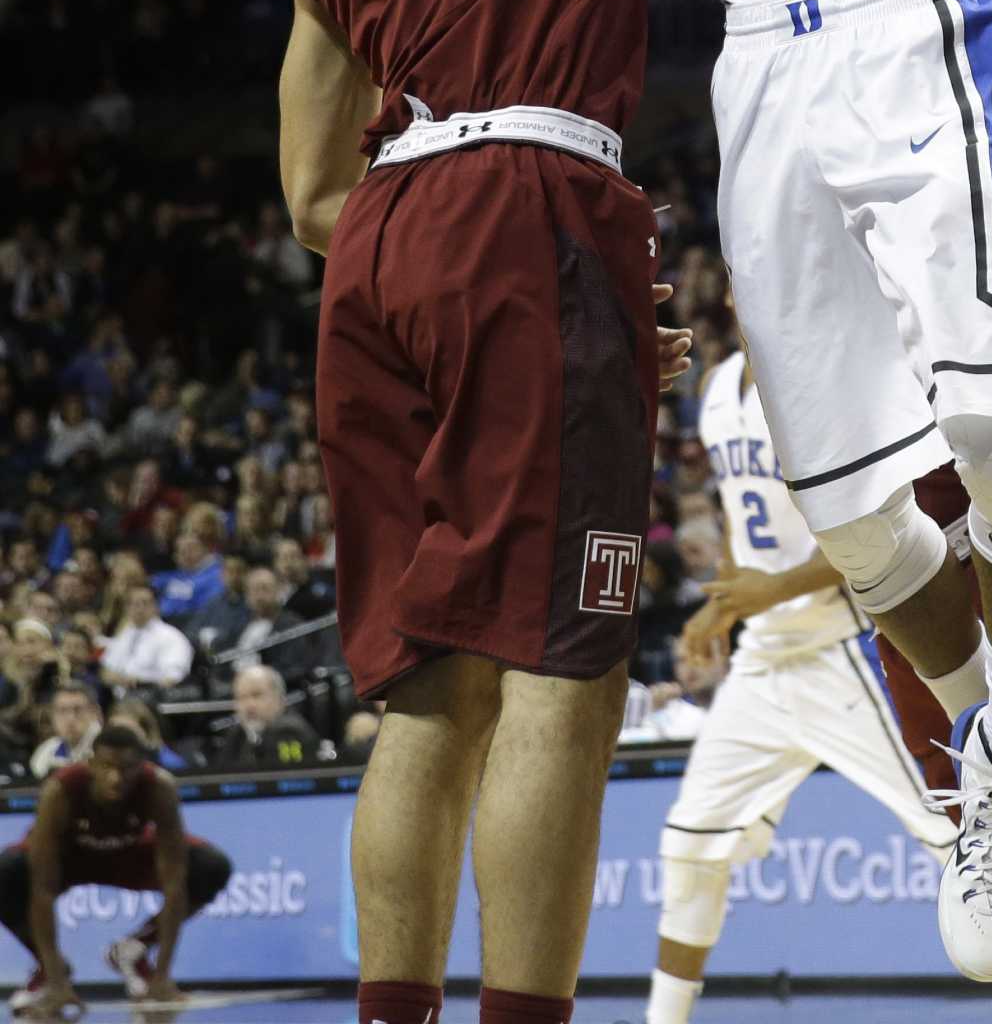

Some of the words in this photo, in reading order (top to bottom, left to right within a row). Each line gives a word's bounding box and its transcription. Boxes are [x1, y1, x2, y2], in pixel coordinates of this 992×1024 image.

[498, 120, 556, 134] ARMOUR
[560, 129, 599, 149] UNDER
[742, 491, 779, 549] 2
